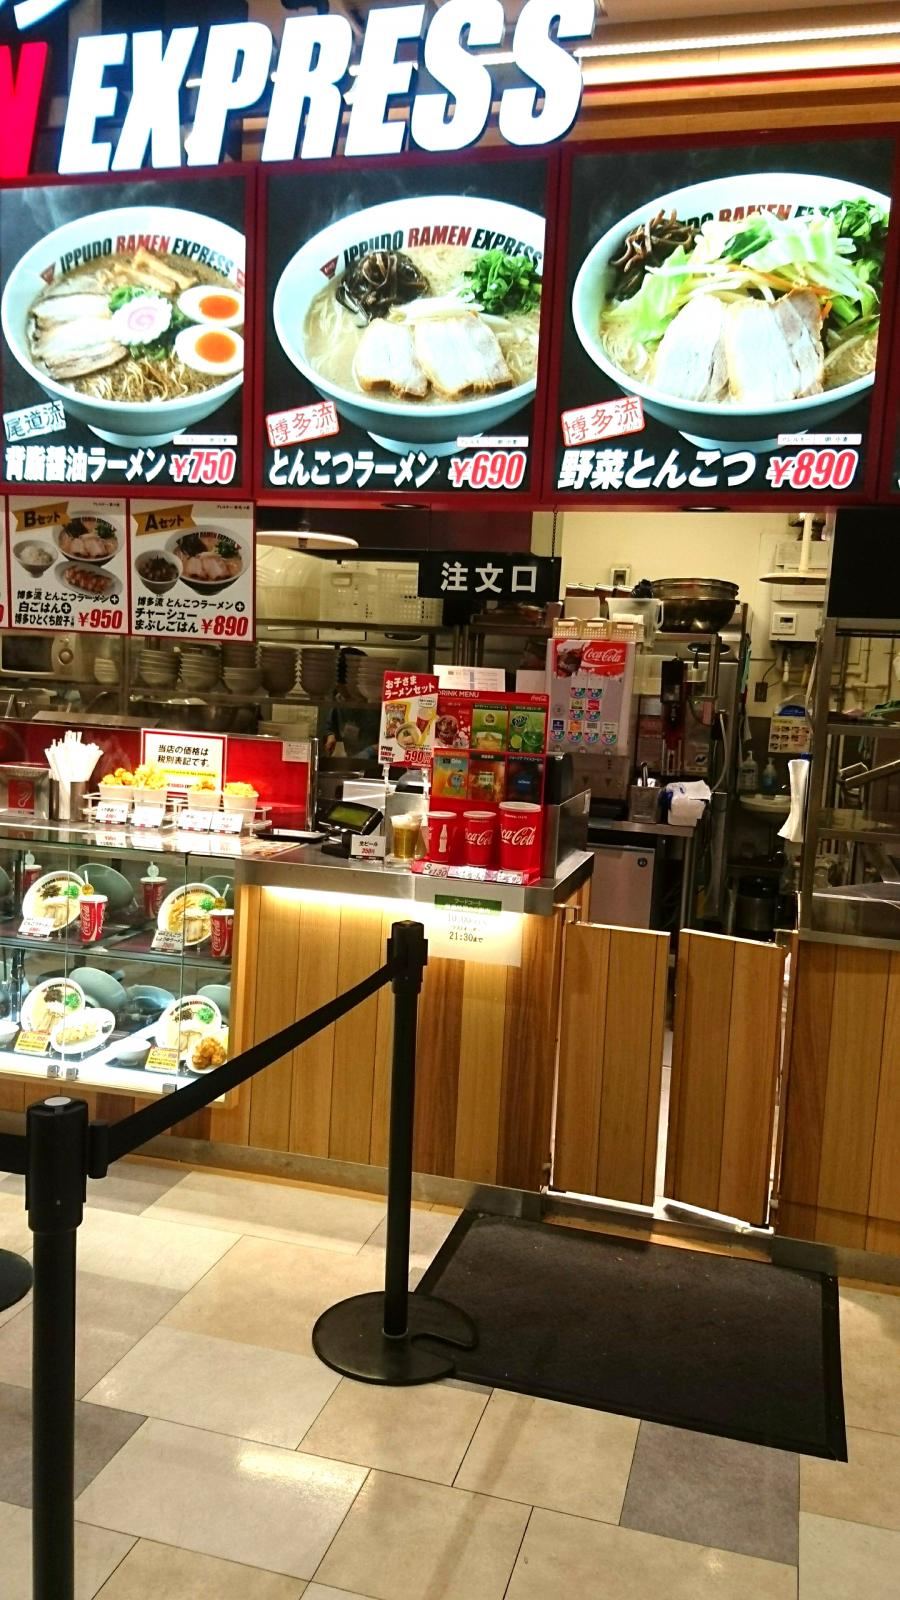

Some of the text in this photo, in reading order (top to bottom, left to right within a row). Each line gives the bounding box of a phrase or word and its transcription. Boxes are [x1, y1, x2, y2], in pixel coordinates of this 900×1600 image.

[58, 0, 594, 175] EXPRESS
[407, 226, 472, 248] RAMEN
[60, 235, 234, 277] IPPUDO RAMEN EXPRESS
[268, 402, 337, 446] 博多流
[563, 399, 642, 444] 博多流
[169, 448, 236, 484] ¥750
[268, 449, 526, 490] とんこつラーメン ¥690
[558, 448, 859, 490] 野菜とんこつ ¥890
[24, 510, 61, 528] Bセット
[145, 513, 185, 531] Aセット
[440, 561, 538, 593] 注文口
[19, 601, 61, 614] 白ごはん
[45, 592, 109, 603] とんこつラーメン
[166, 598, 234, 610] とんこつラーメン
[78, 608, 123, 630] ¥950
[135, 607, 198, 620] チャーシュー
[135, 615, 249, 637] まぶしごはん ¥890
[385, 675, 417, 689] お子さま
[385, 682, 435, 699] ラーメンセット
[458, 690, 480, 698] MENU
[158, 744, 209, 756] 当店の価格は
[157, 755, 210, 767] 税別表記です。
